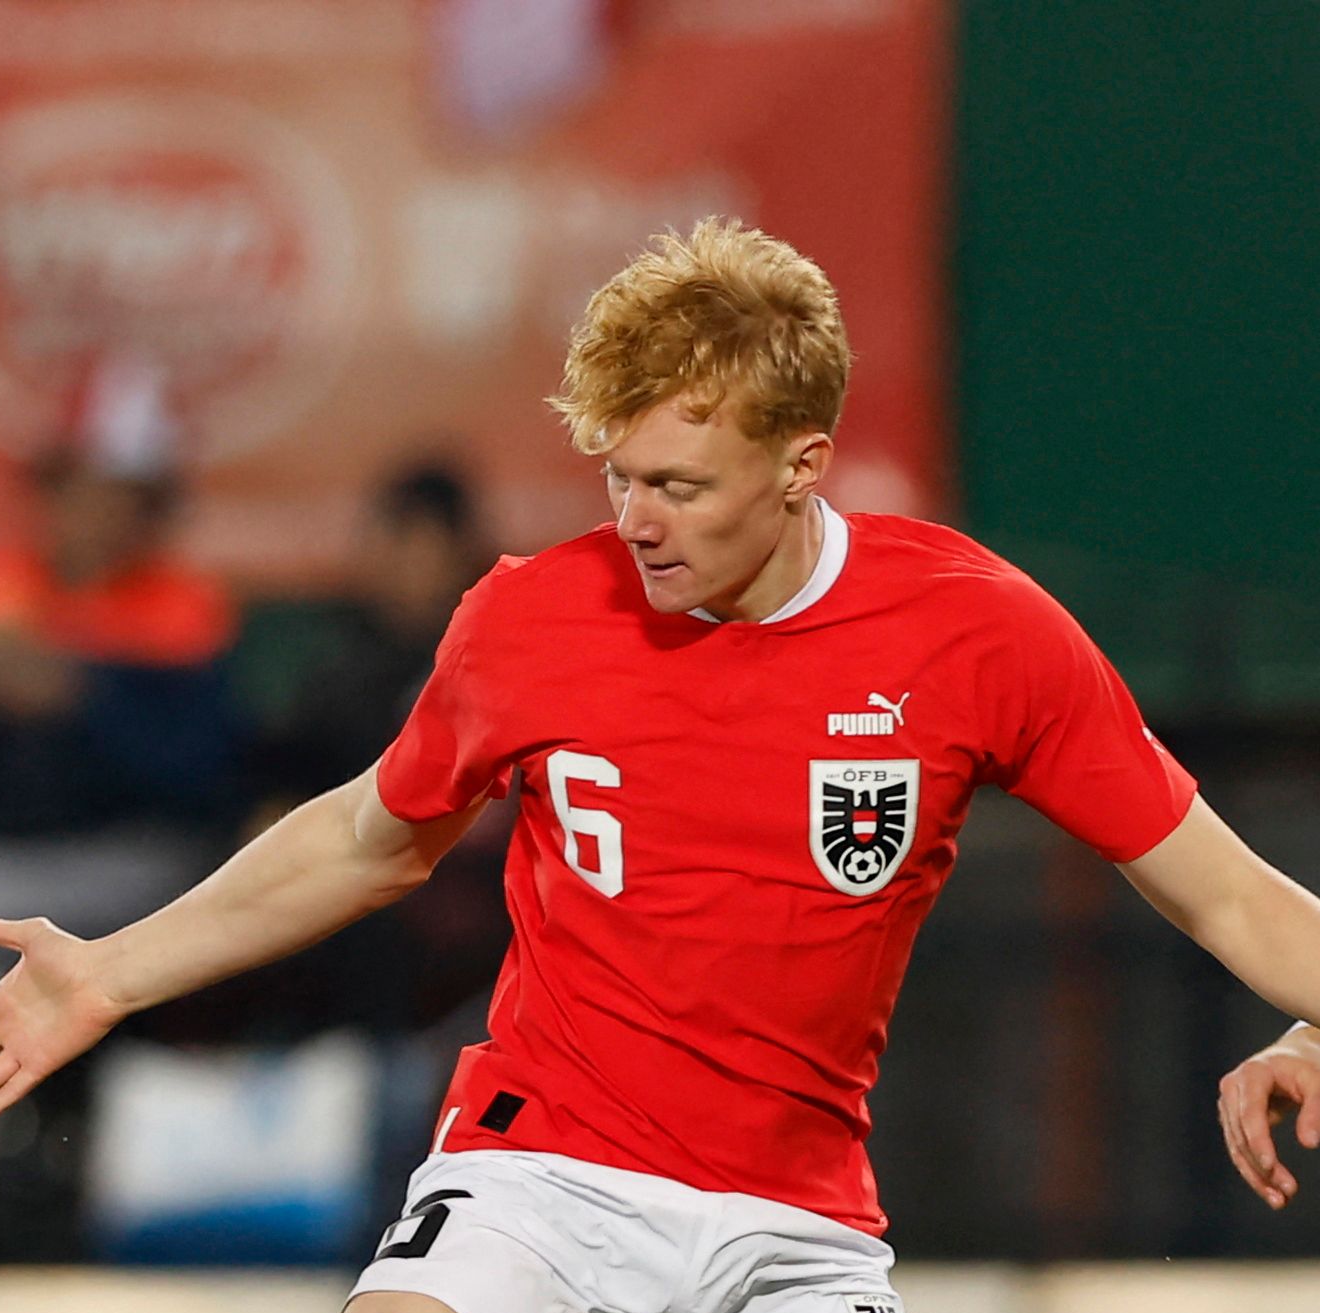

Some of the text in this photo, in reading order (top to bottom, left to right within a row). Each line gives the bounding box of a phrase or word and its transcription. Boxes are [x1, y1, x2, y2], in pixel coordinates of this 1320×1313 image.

[827, 712, 894, 736] PUMA
[843, 768, 887, 782] ÖFB
[546, 749, 625, 898] 6
